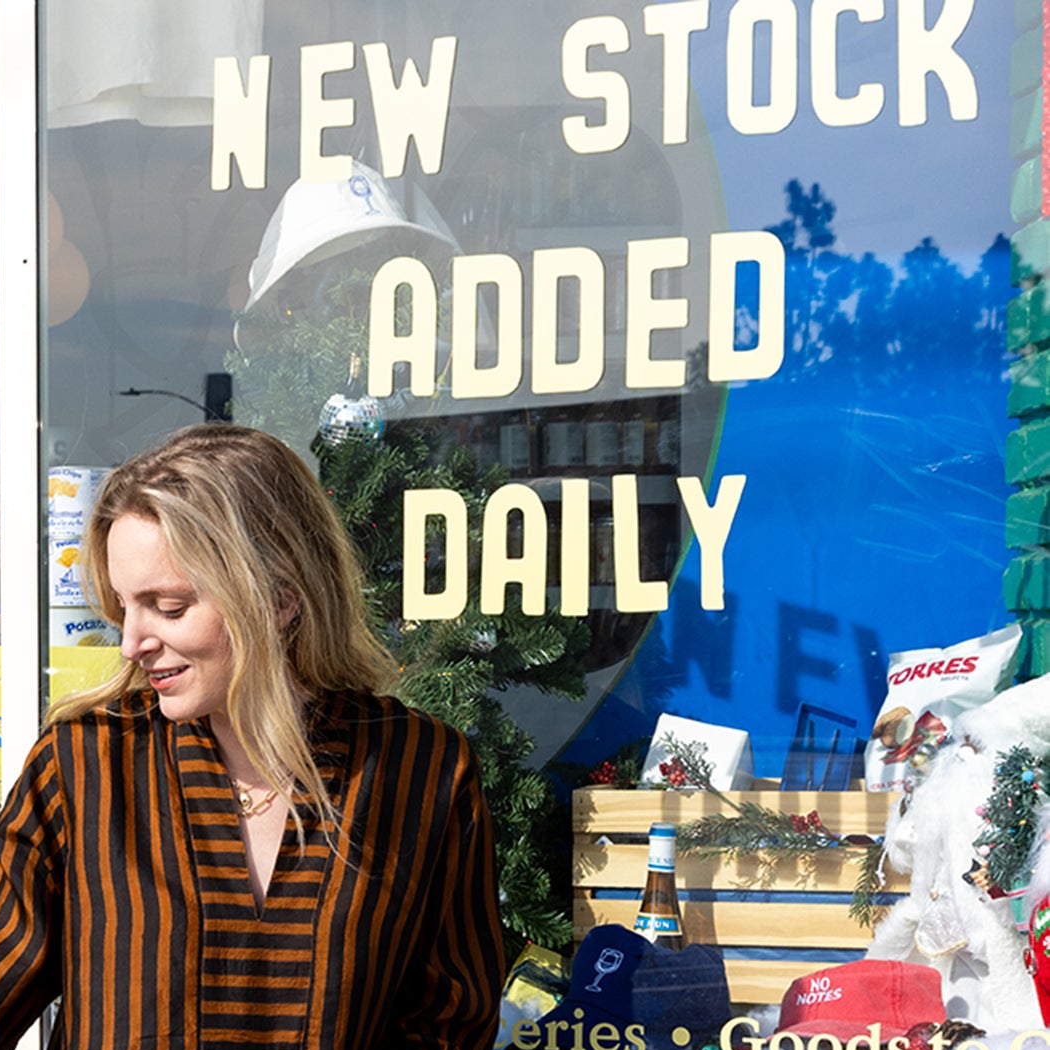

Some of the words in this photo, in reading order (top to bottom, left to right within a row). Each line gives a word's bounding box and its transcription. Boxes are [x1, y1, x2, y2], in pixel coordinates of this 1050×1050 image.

[211, 37, 457, 190] NEW
[561, 0, 978, 154] STOCK
[367, 231, 785, 399] ADDED
[403, 474, 747, 621] DAILY
[796, 988, 842, 1006] NOTES
[810, 977, 830, 991] NO
